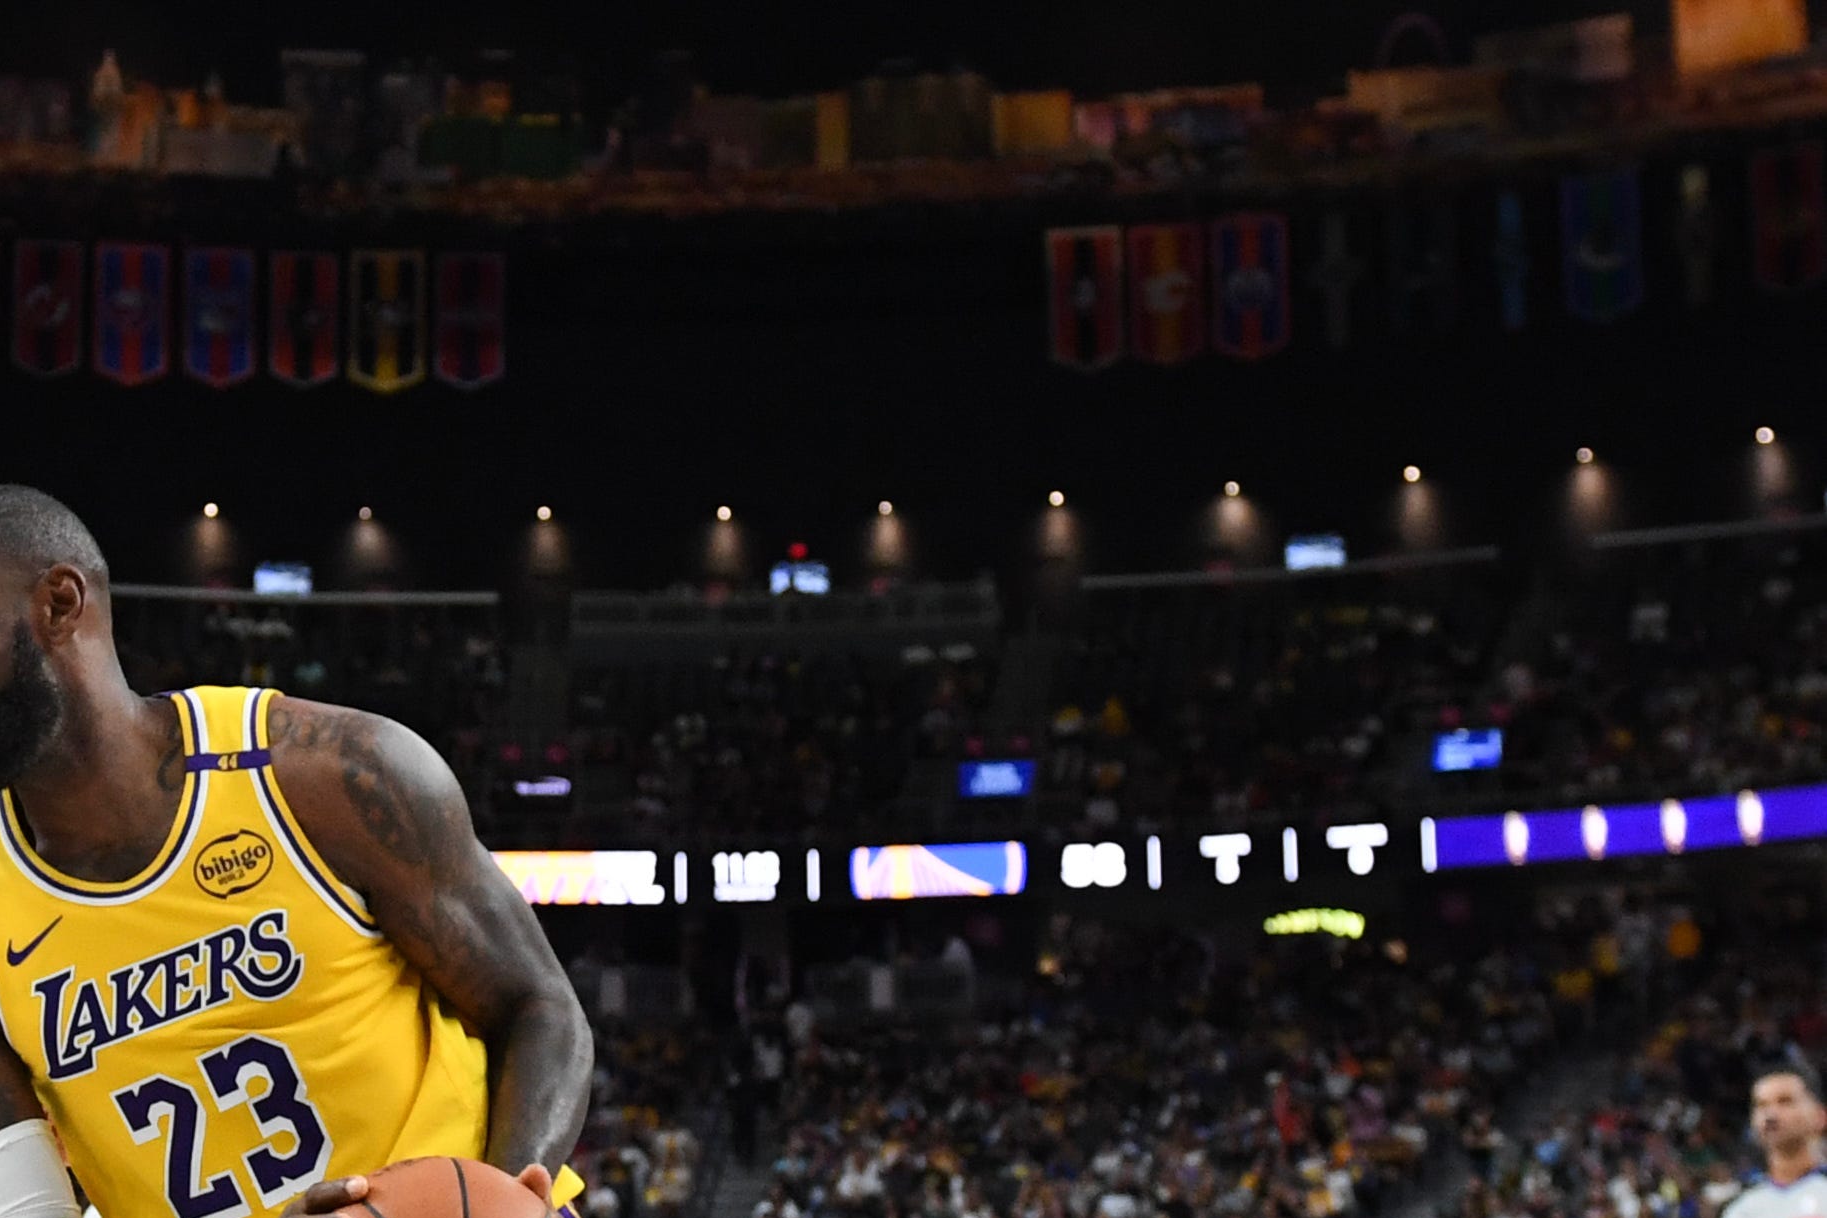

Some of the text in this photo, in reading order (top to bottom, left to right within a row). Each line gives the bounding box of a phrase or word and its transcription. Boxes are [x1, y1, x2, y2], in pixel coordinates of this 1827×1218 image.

[217, 753, 238, 770] 44
[200, 845, 267, 881] bibigo
[31, 908, 305, 1083] LAKERS
